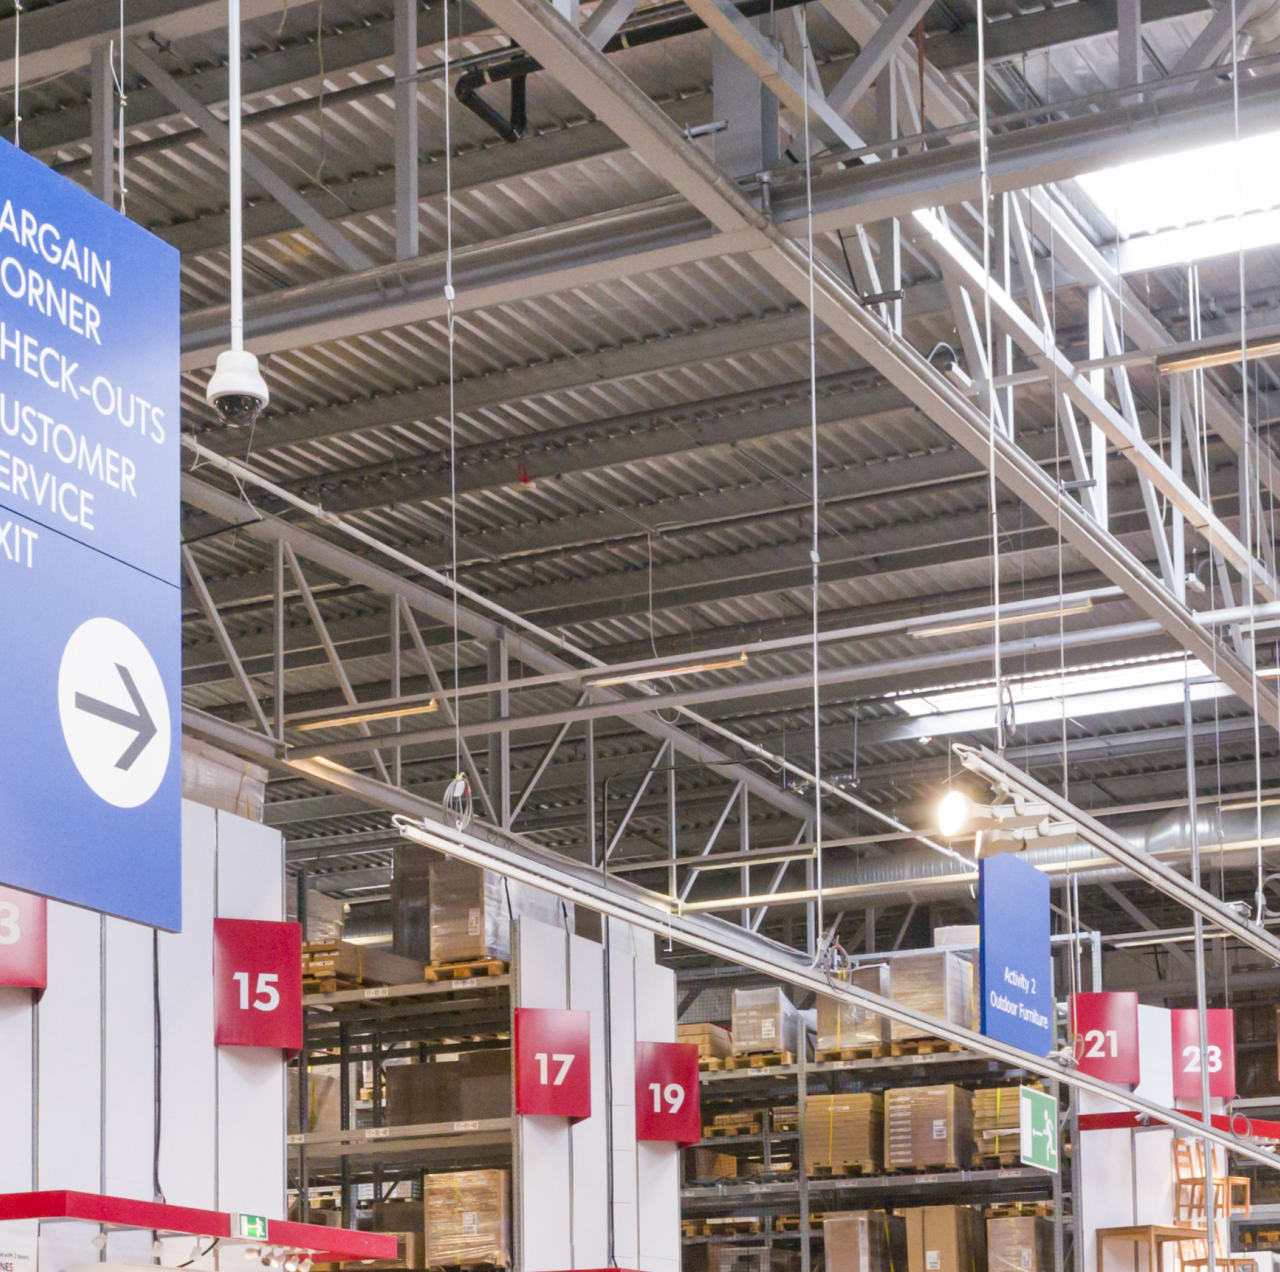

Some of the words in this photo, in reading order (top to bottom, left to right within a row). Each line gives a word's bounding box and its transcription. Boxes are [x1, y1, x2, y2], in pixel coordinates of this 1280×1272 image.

[232, 971, 280, 1012] 15
[1004, 966, 1030, 995] Activity
[1031, 978, 1037, 995] 2
[990, 990, 1018, 1016] Outdoor
[1019, 1002, 1049, 1030] Furniture
[1084, 1029, 1119, 1058] 21
[1182, 1045, 1223, 1073] 23
[534, 1053, 576, 1086] 17
[648, 1083, 685, 1114] 19
